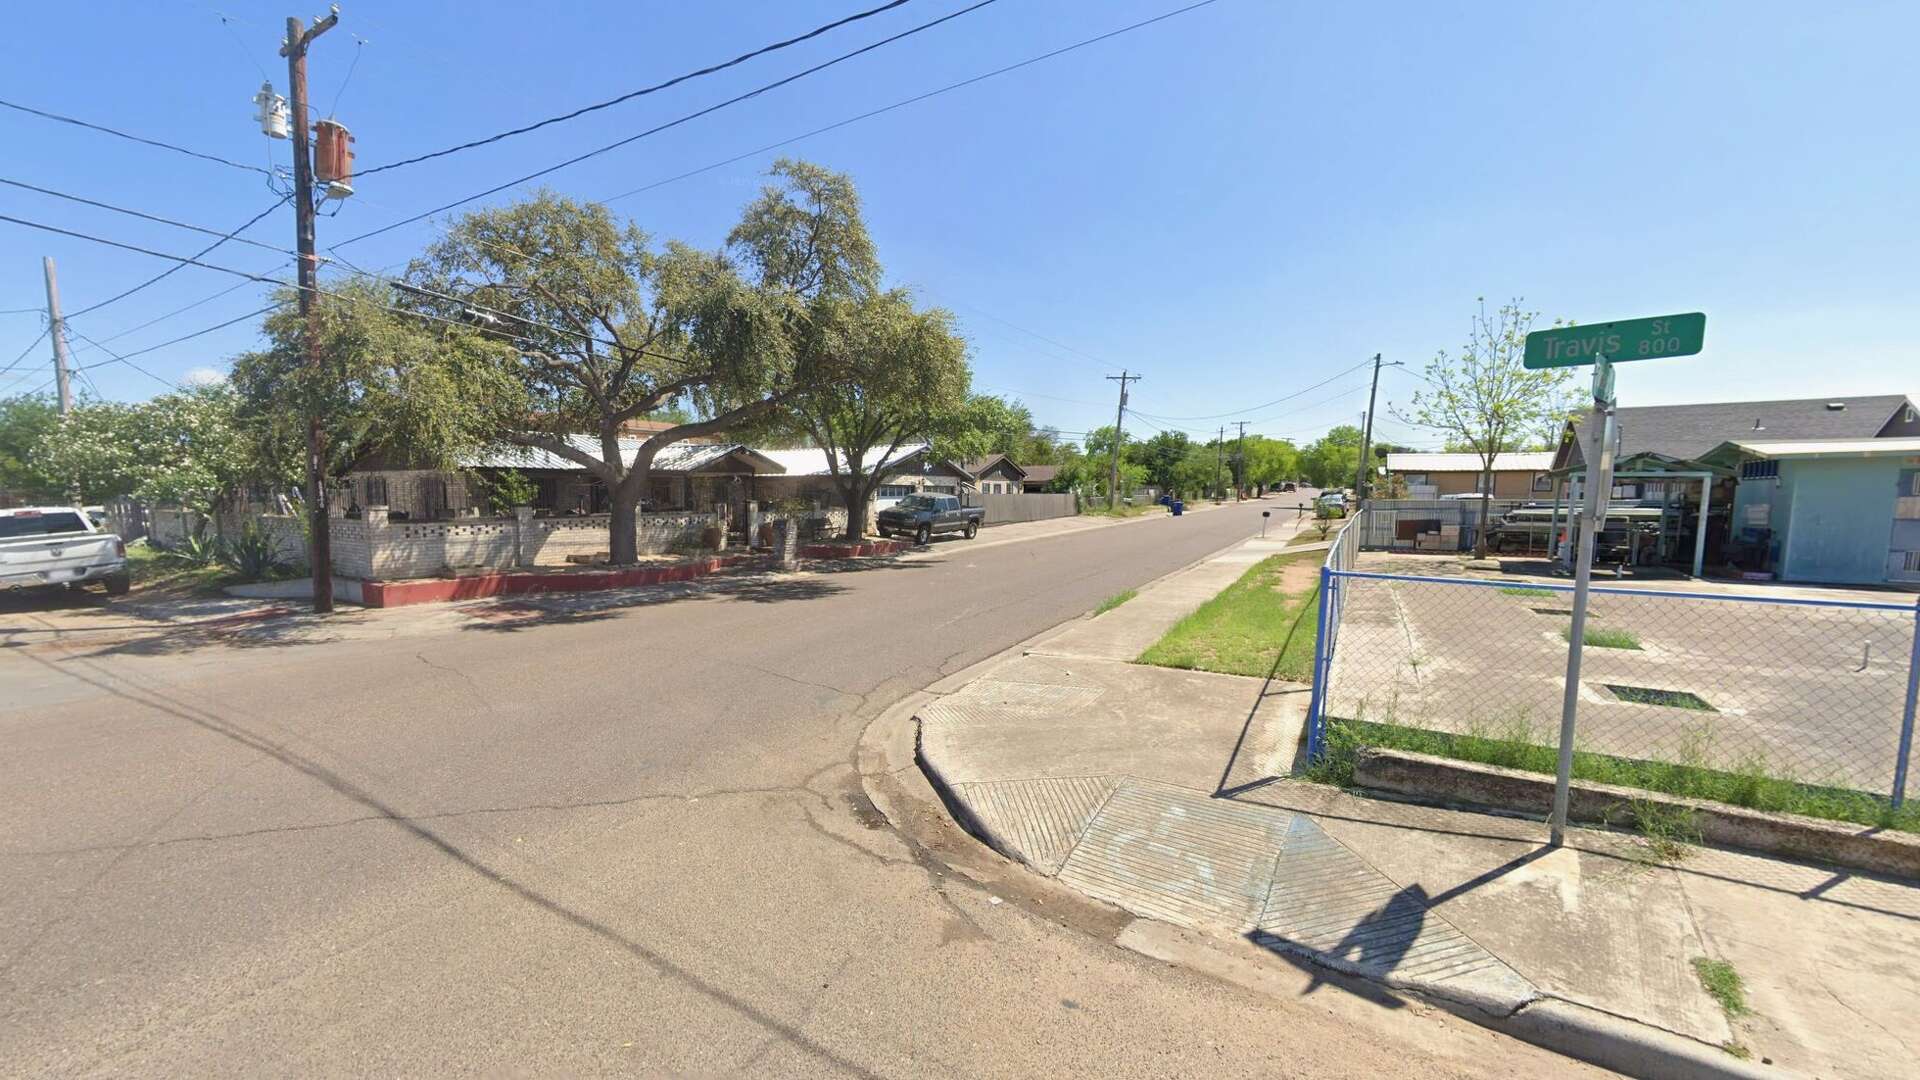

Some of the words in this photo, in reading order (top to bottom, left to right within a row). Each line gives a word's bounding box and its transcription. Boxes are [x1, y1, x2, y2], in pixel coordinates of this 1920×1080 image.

[1544, 331, 1621, 360] Travis
[1652, 319, 1670, 336] St
[1638, 336, 1680, 356] 800
